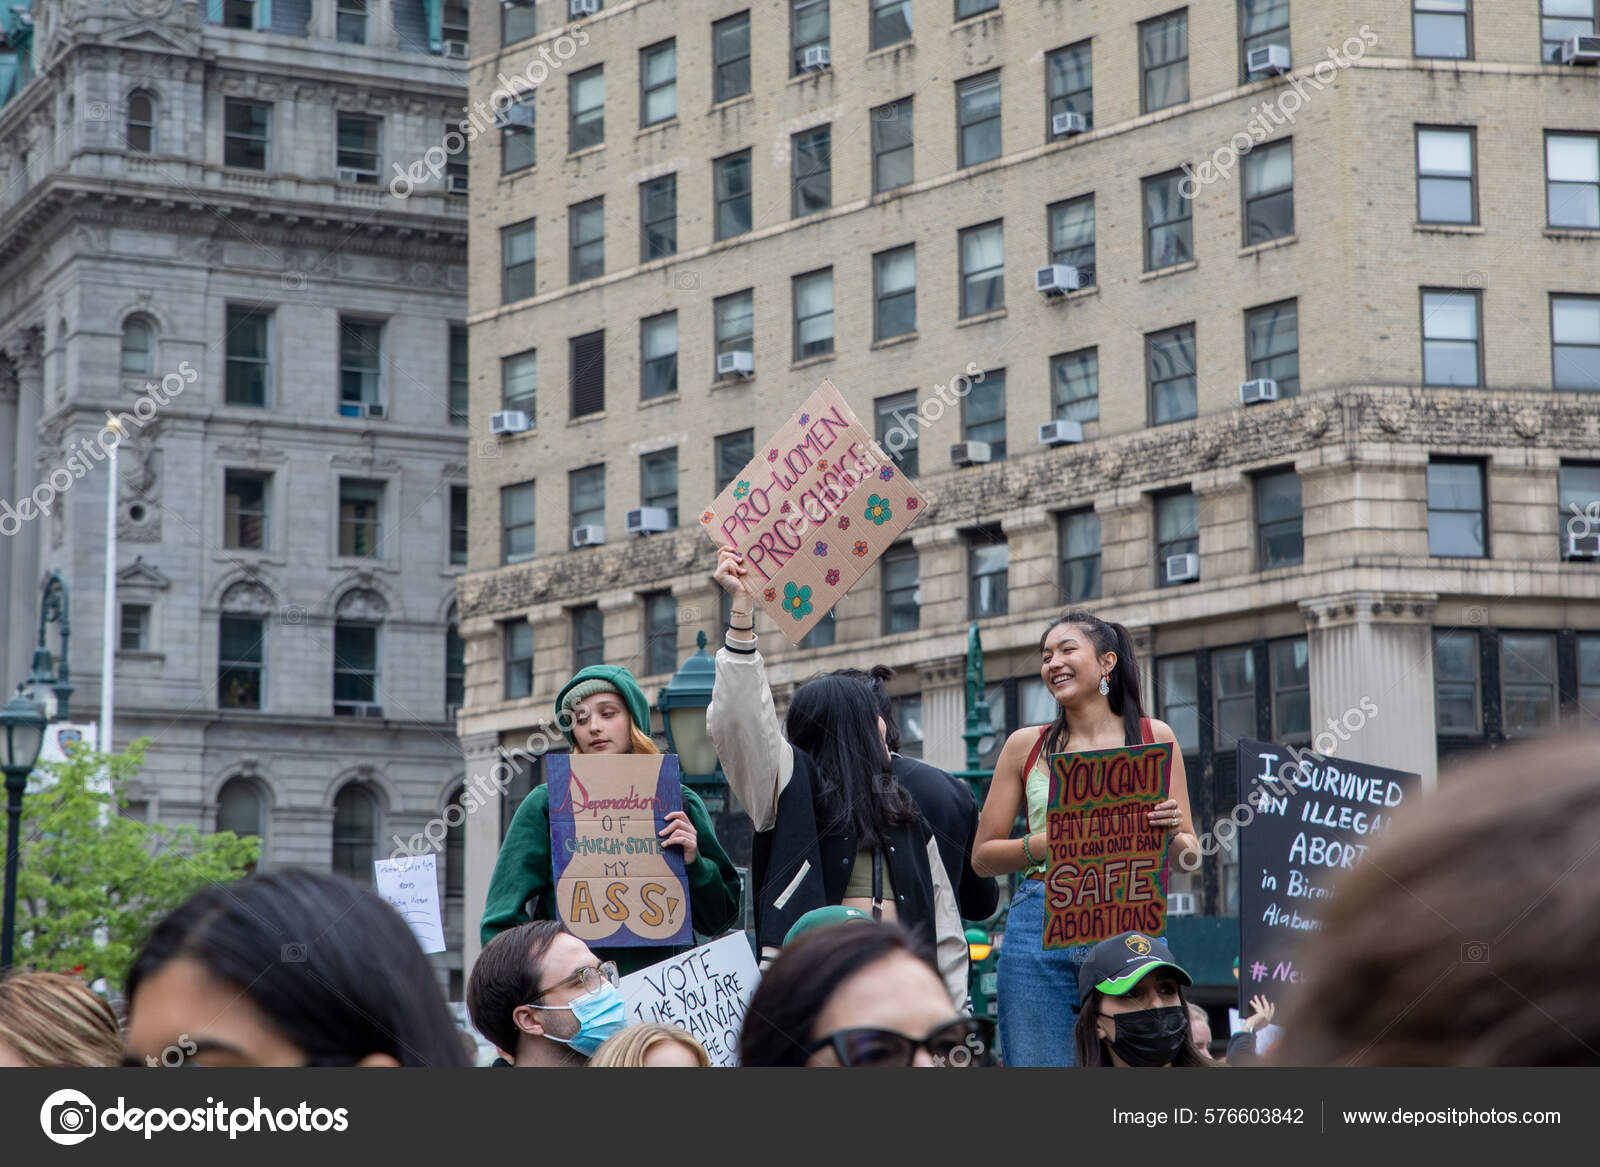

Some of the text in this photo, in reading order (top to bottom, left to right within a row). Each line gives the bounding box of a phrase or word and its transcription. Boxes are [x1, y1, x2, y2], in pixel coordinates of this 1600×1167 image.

[720, 406, 849, 548] PRO-WOMEN
[1258, 753, 1402, 807] I SURVIVED
[1257, 792, 1288, 816] AN
[602, 815, 630, 833] OF
[1050, 810, 1084, 841] BAN
[1049, 834, 1162, 862] YOU CAN ONLY BAN
[1289, 832, 1368, 869] ABORT
[604, 861, 629, 876] MY
[1049, 859, 1155, 910] SAFE
[1261, 869, 1277, 890] in
[570, 880, 680, 926] ASS!
[1048, 902, 1163, 943] ABORTIONS
[643, 948, 719, 997] VOTE
[675, 986, 707, 1014] YOU
[714, 972, 743, 1002] ARE
